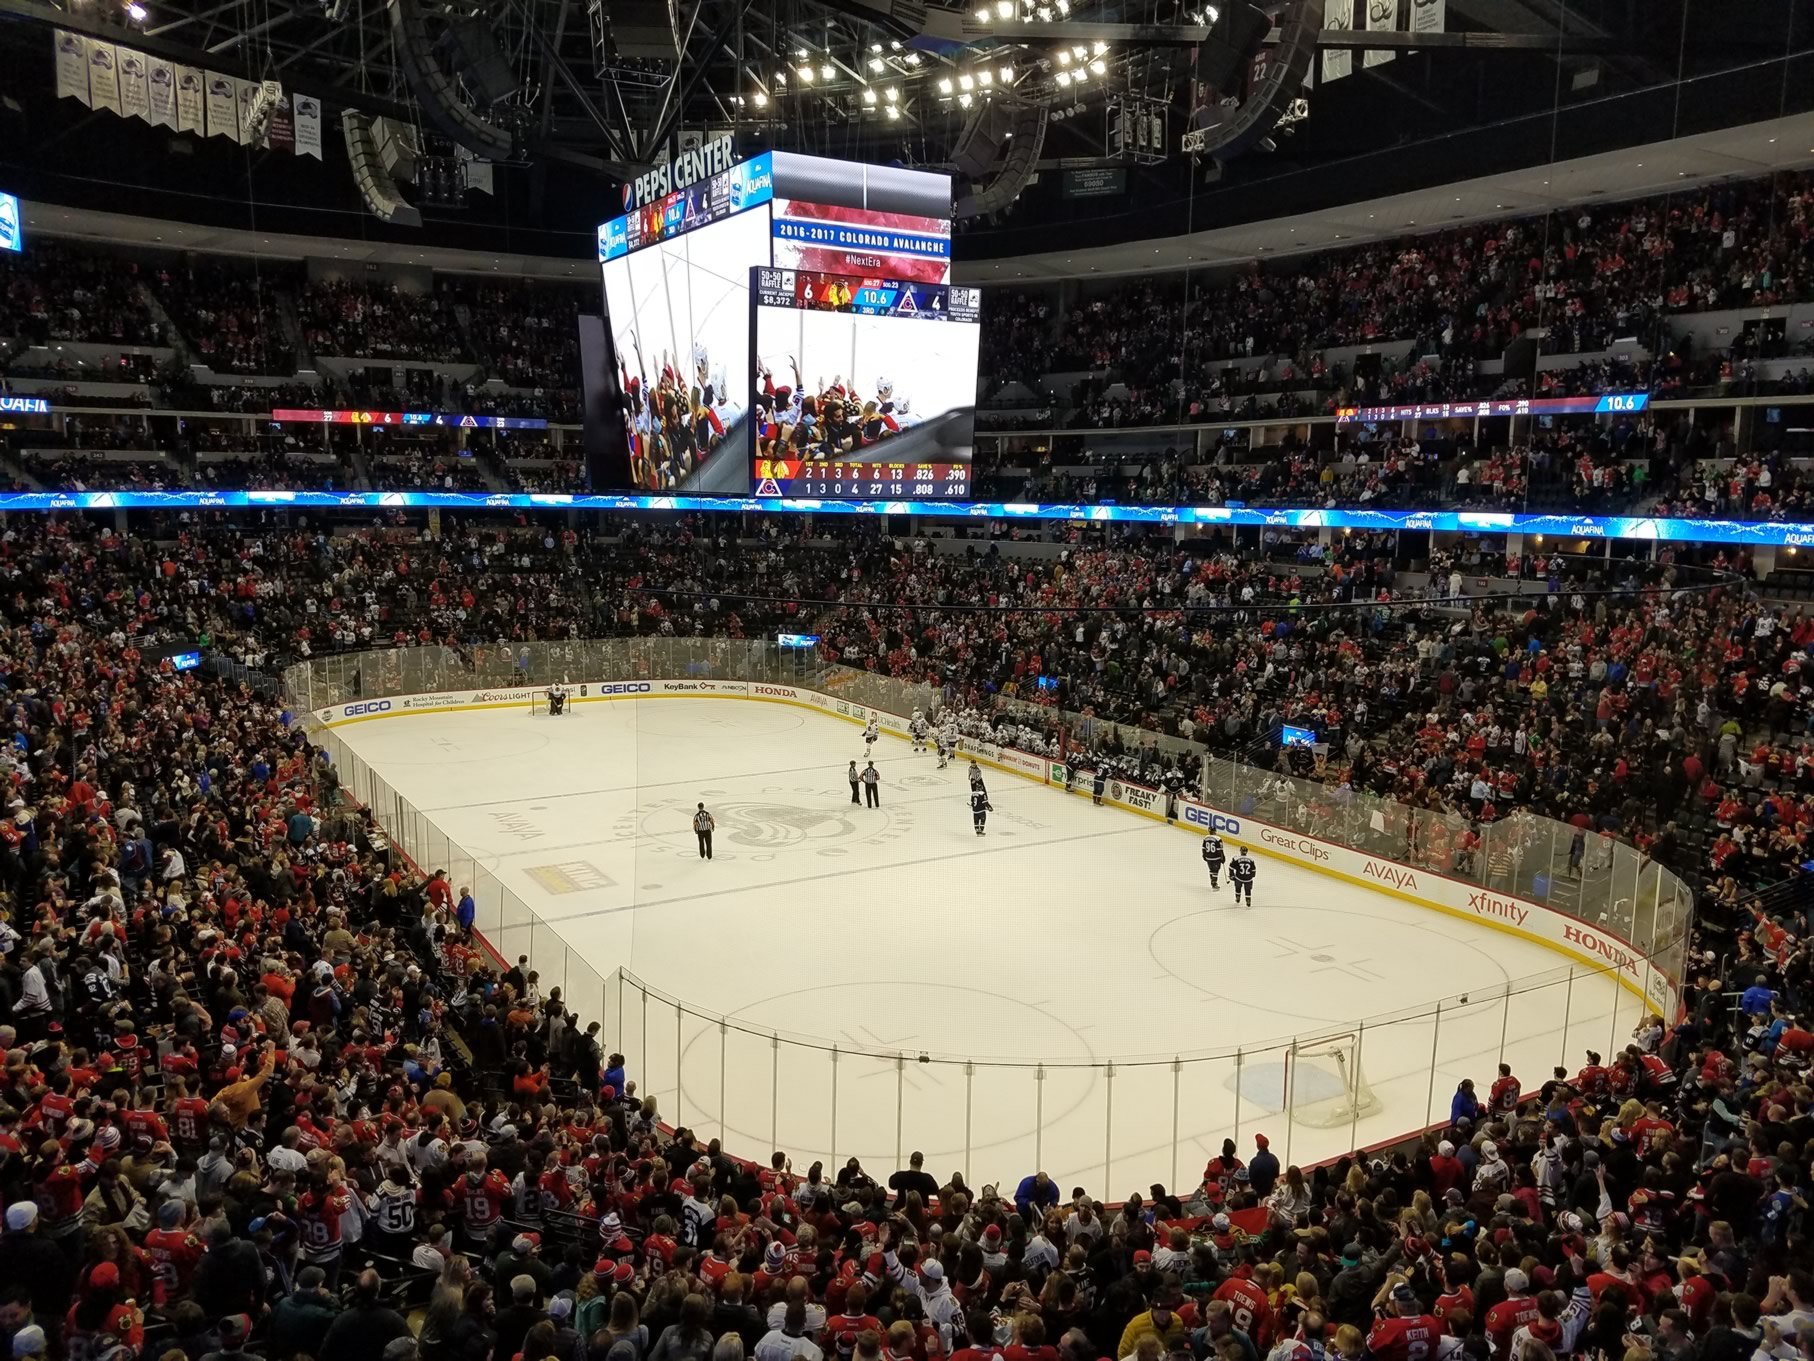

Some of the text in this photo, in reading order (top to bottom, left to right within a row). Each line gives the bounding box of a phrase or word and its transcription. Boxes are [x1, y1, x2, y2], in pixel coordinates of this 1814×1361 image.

[1253, 62, 1266, 82] 22
[634, 135, 734, 208] PEPSI CENTER
[702, 193, 708, 210] 4
[643, 218, 649, 233] 6
[780, 224, 944, 254] 2016-2017 COLORADO AVALANCHE
[845, 254, 881, 268] #NextEra
[761, 280, 781, 289] RAFFLE
[804, 283, 813, 299] 6
[764, 295, 790, 306] $8,372
[864, 290, 886, 304] 10.6
[932, 295, 941, 310] 4
[1607, 396, 1634, 410] 10.6
[384, 413, 391, 423] 6
[436, 415, 443, 425] 4
[806, 468, 966, 480] 2 1 3 6 6 13 .826 .390
[805, 483, 965, 495] 1 3 0 4 27 15 .808 .610
[50, 499, 77, 507] AQUAFINA
[199, 497, 226, 505] AQUAFINA
[339, 497, 366, 505] AQUAFINA
[486, 498, 510, 506] AQUAFINA
[1405, 518, 1433, 528] AQUAFINA
[1571, 524, 1606, 536] AQUAFINA
[601, 683, 651, 694] GEICO
[755, 686, 798, 698] HONDA
[413, 700, 434, 708] Hospital
[481, 692, 531, 702] Coors LIGHT
[810, 693, 828, 707] AVAYA
[344, 700, 391, 717] GEICO
[964, 743, 994, 758] DRAFTKINGS
[1022, 760, 1040, 770] DONUTS
[1125, 786, 1157, 803] FREAKY
[1128, 796, 1151, 810] FAST!
[1185, 806, 1240, 835] GEICO
[1205, 841, 1216, 853] 96
[1261, 828, 1329, 861] Great Clips
[1239, 863, 1251, 875] 32
[1363, 861, 1417, 890] AVAYA
[1468, 892, 1529, 926] xfinity
[1563, 924, 1639, 978] HONDA
[178, 1117, 199, 1139] 81
[388, 1201, 415, 1229] 50
[463, 1196, 490, 1220] 19
[1025, 1252, 1046, 1267] ELFOUR
[1233, 1290, 1257, 1310] TOEWS
[1406, 1327, 1429, 1341] KEITH
[1408, 1341, 1429, 1361] 2
